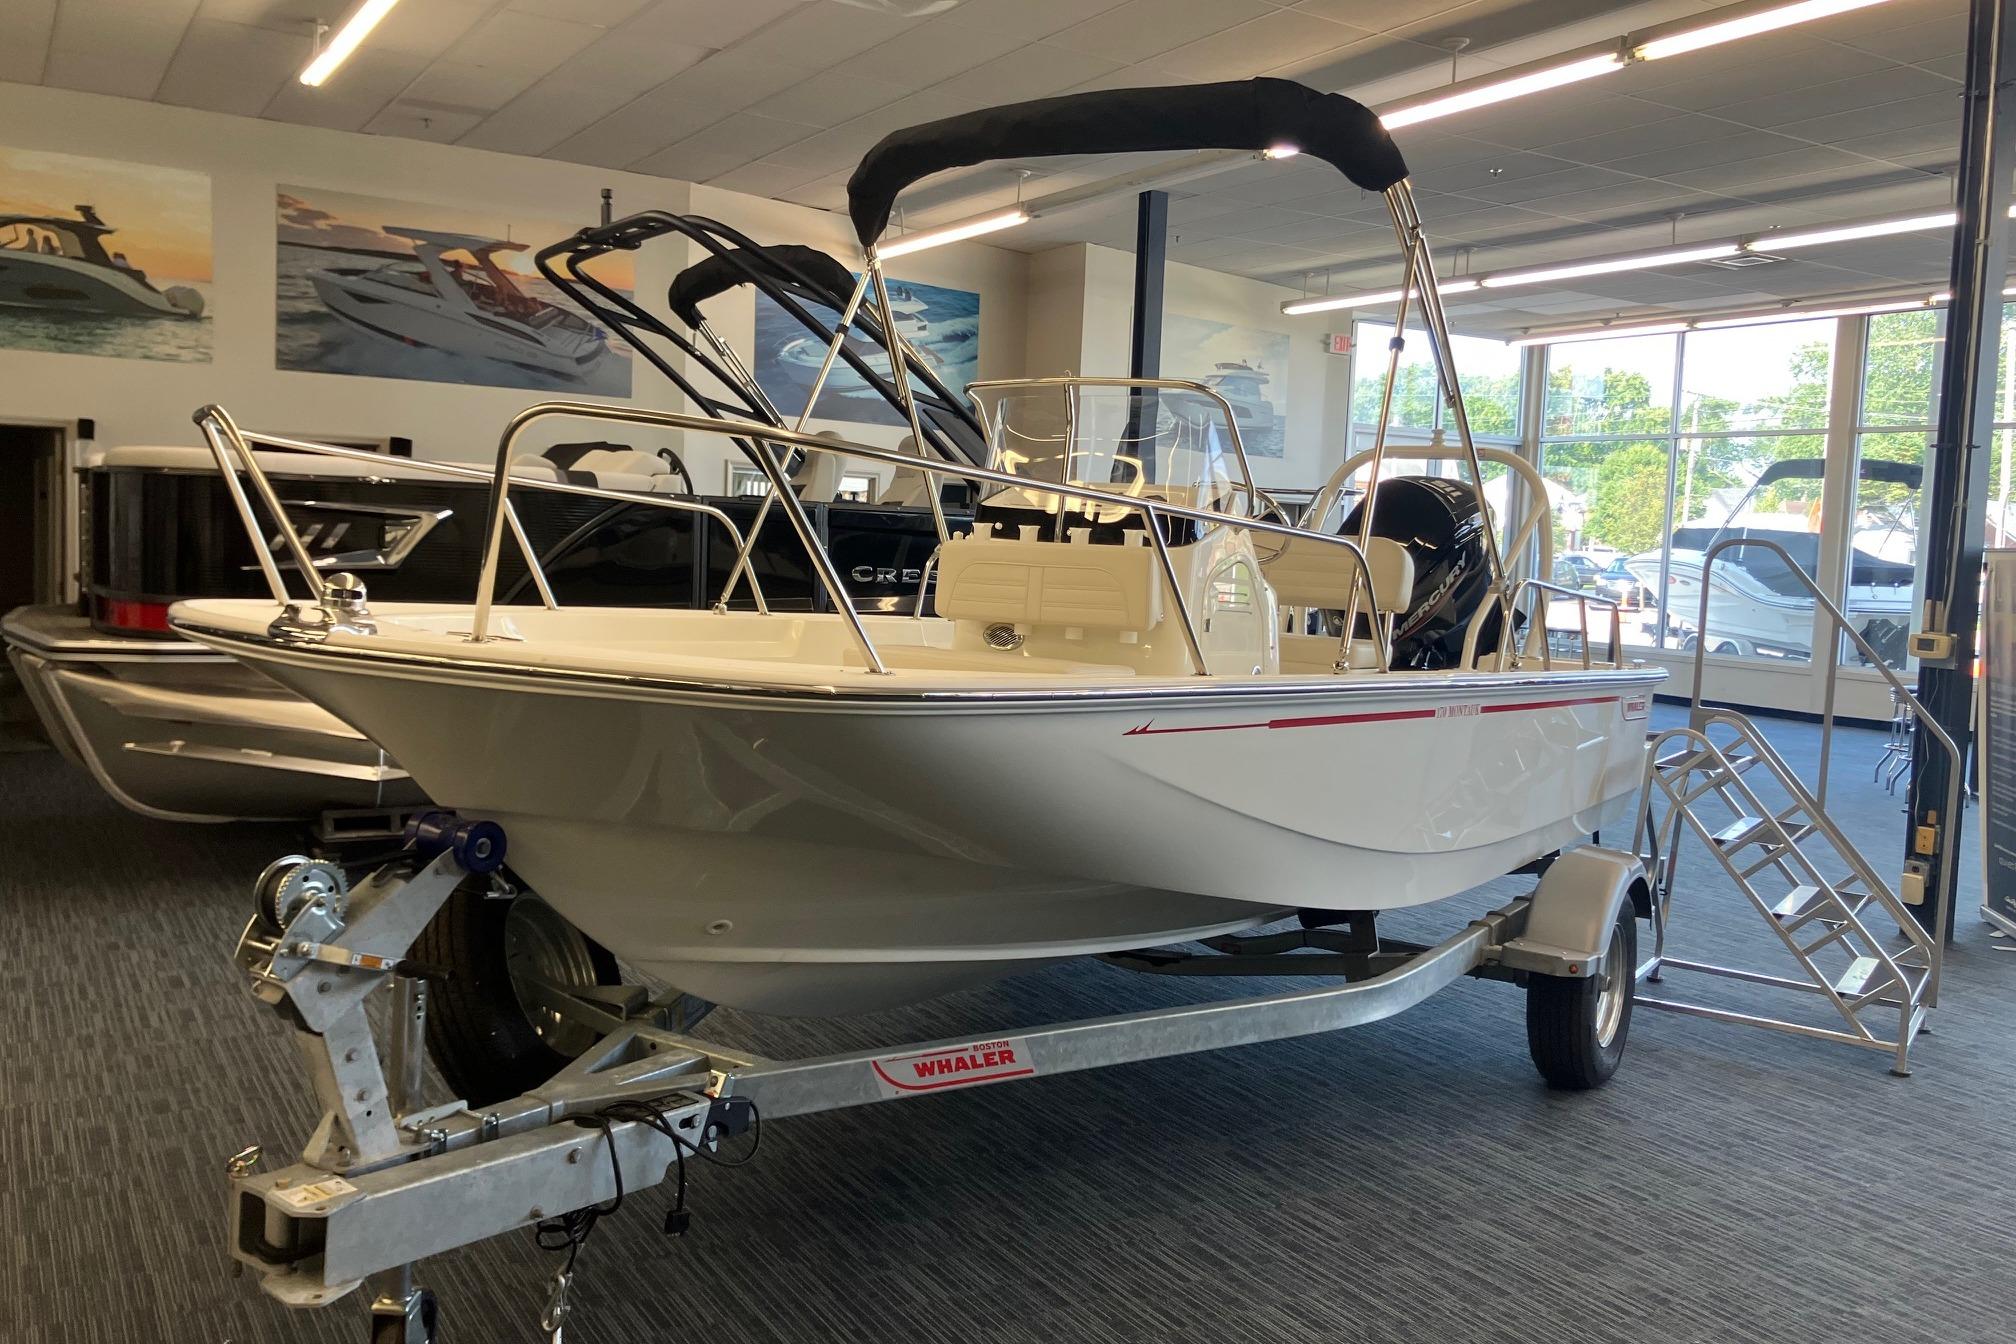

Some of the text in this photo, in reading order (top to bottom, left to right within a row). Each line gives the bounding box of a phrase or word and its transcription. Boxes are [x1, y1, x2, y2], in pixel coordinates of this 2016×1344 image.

[1392, 550, 1466, 640] MERCURY
[1448, 703, 1480, 718] MONTAUK
[973, 1040, 1009, 1052] BOSTON
[913, 1049, 1016, 1078] WHALER
